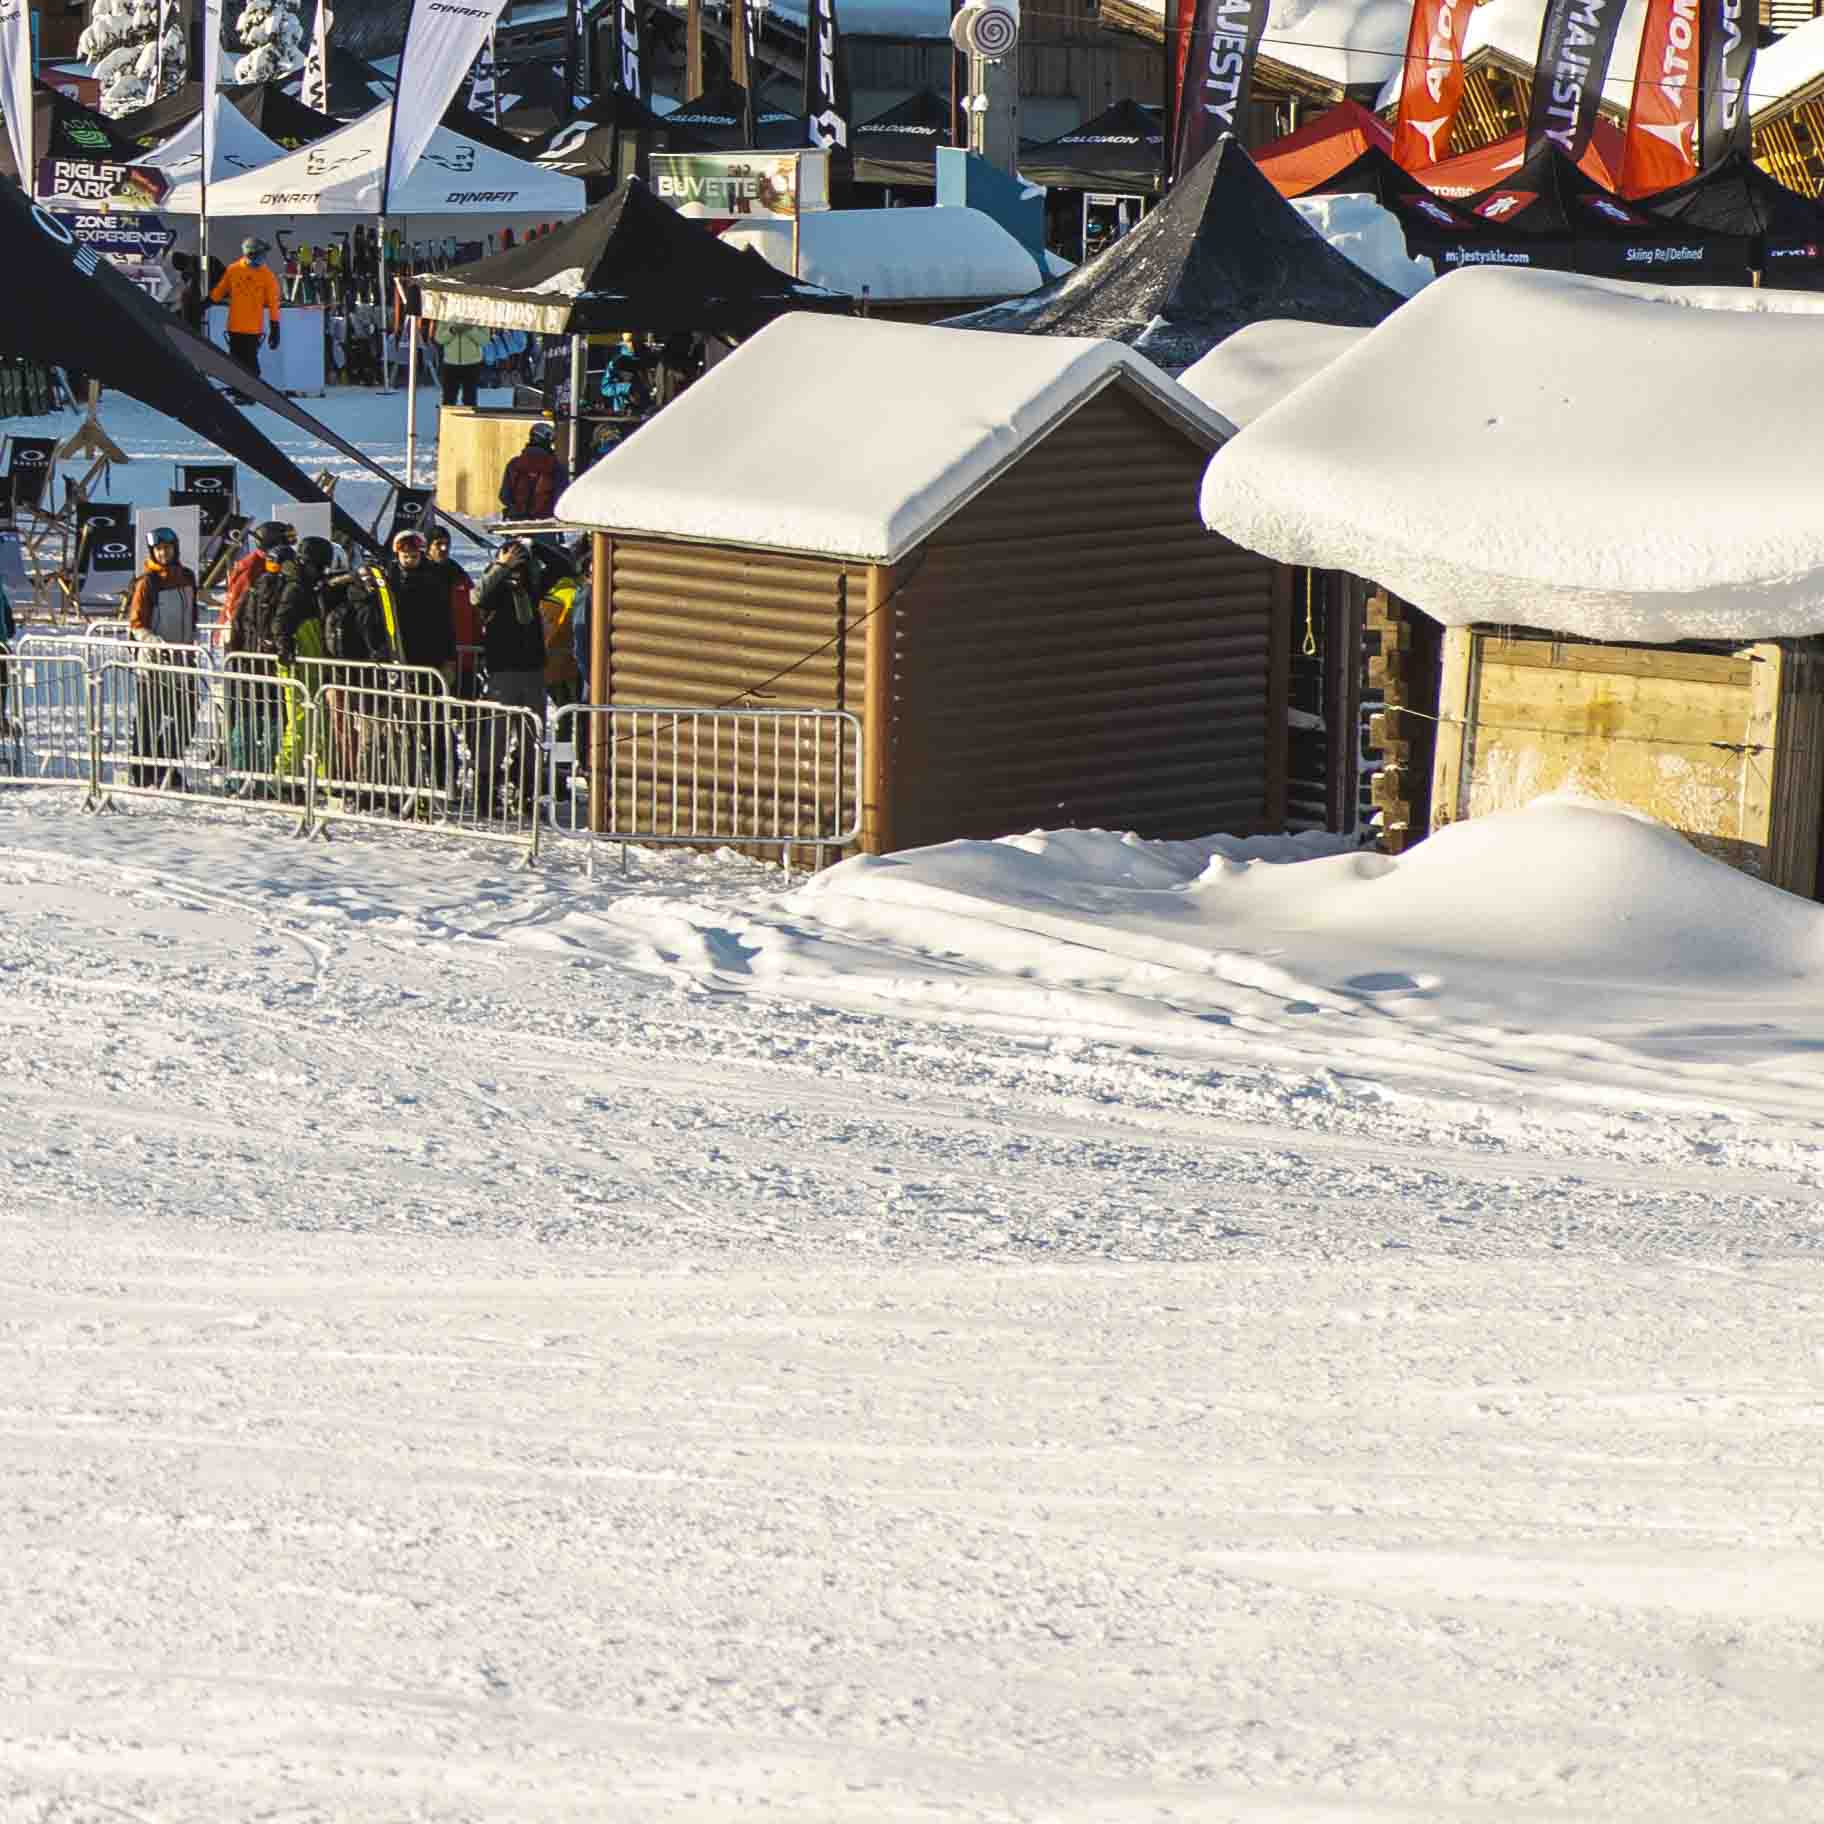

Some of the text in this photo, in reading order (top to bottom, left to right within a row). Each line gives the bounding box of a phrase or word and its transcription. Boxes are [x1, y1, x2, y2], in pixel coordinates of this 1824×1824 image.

[428, 3, 494, 21] DYNAFIT
[666, 113, 737, 127] SALOMON
[856, 122, 938, 137] SALOMON
[1056, 133, 1140, 146] SALOMON
[54, 161, 126, 183] RIGLET
[54, 178, 116, 198] PARK
[260, 192, 322, 207] DYNAFIT
[445, 191, 520, 205] DYNAFIT
[74, 215, 118, 229] ZONE
[75, 229, 168, 244] EXPERIENCE
